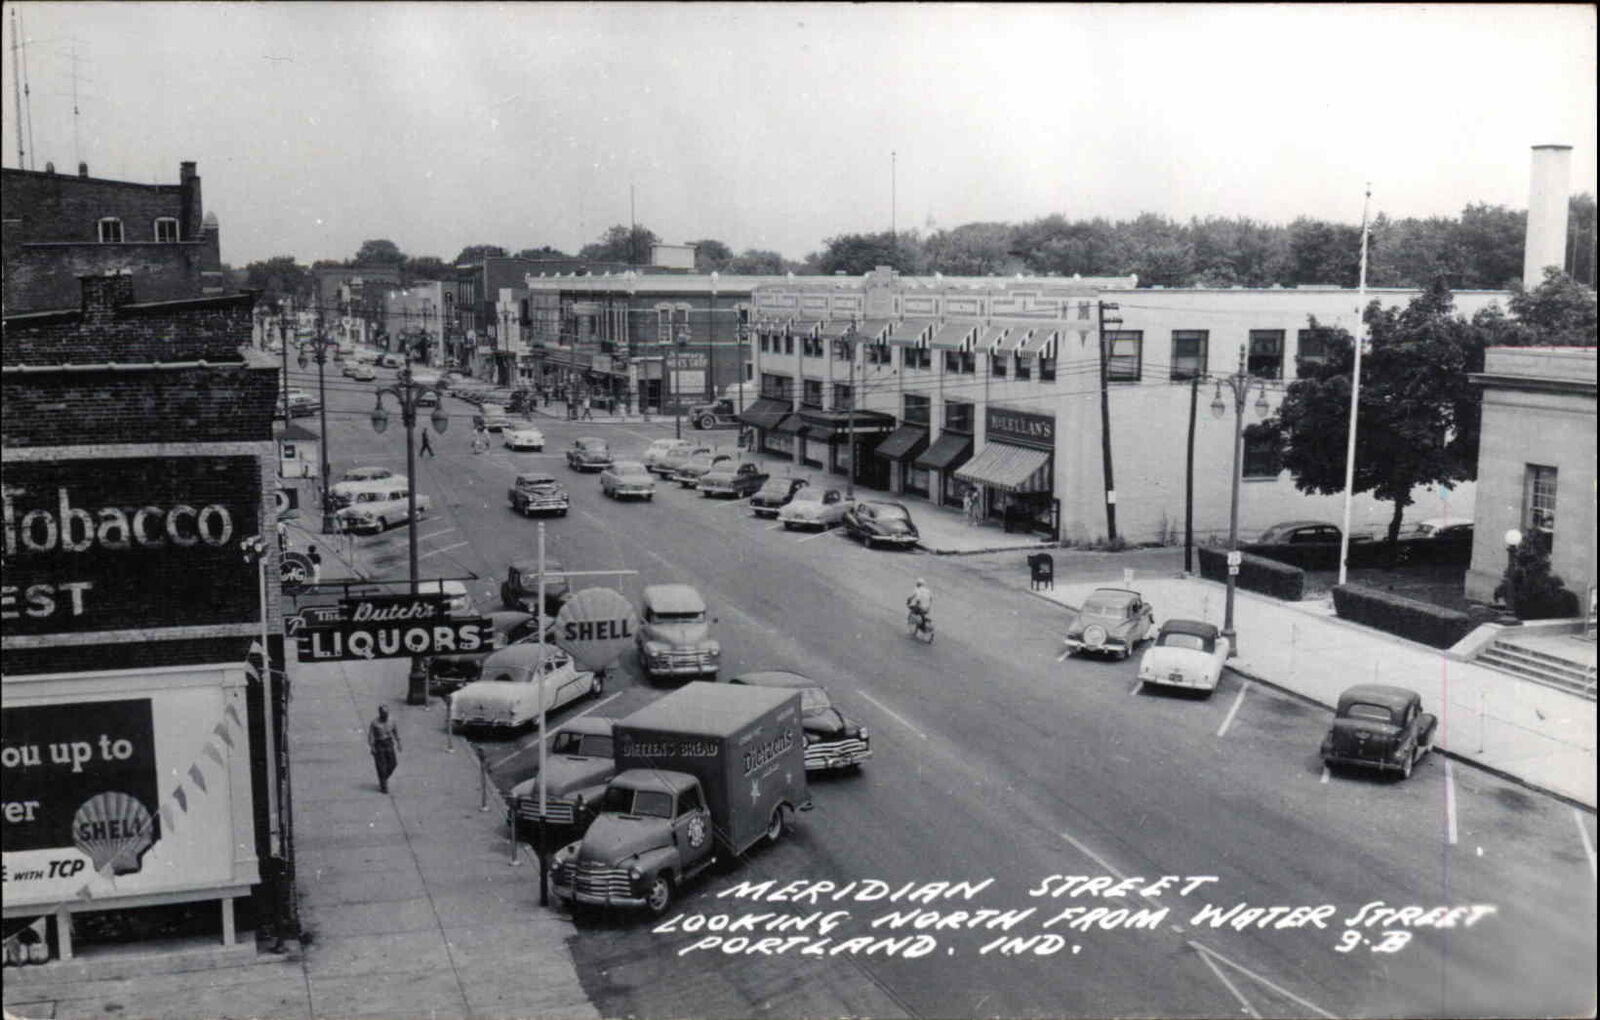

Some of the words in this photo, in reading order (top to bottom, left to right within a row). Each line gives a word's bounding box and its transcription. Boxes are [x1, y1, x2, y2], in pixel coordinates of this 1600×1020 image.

[2, 486, 233, 551] Tobacco
[353, 602, 434, 622] Dutch's
[565, 619, 632, 641] SHELL
[312, 625, 481, 660] LIQUORS
[49, 741, 92, 773] up
[99, 734, 133, 760] to
[79, 819, 144, 842] SHELL
[14, 870, 44, 881] WITH
[48, 860, 85, 878] TCP
